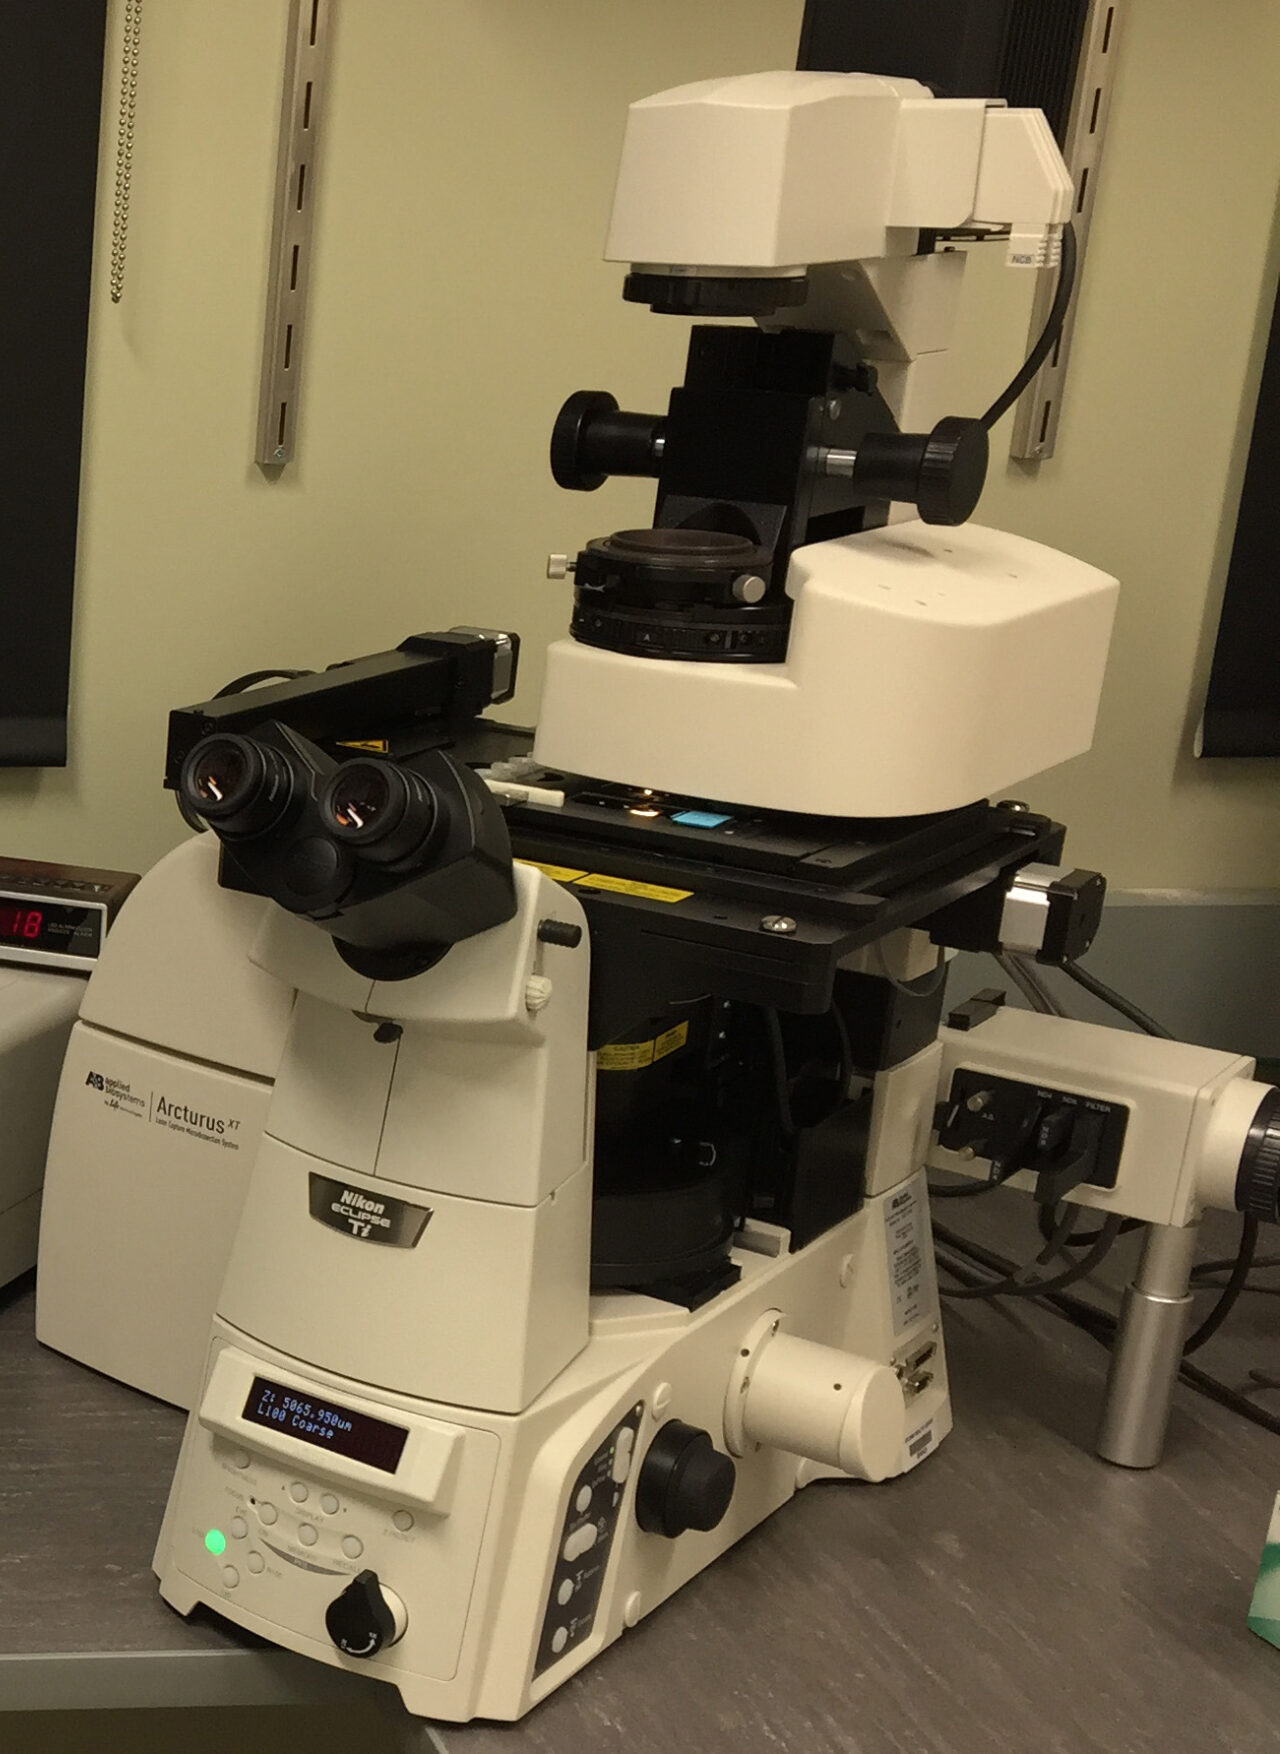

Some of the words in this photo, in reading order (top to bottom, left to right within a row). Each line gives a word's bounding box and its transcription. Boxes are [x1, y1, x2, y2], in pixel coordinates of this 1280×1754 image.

[105, 1077, 131, 1093] applied
[105, 1085, 146, 1108] biosystems
[156, 1096, 225, 1135] Arcturus
[227, 1119, 241, 1131] XT
[1085, 1101, 1111, 1113] FILTER
[339, 1189, 386, 1215] Nikon
[331, 1202, 392, 1229] ECLIPSE
[347, 1218, 372, 1238] Ti
[256, 1402, 287, 1422] L100
[291, 1415, 335, 1440] Coarse
[261, 1389, 276, 1403] Z:
[282, 1396, 353, 1432] 5065.950um
